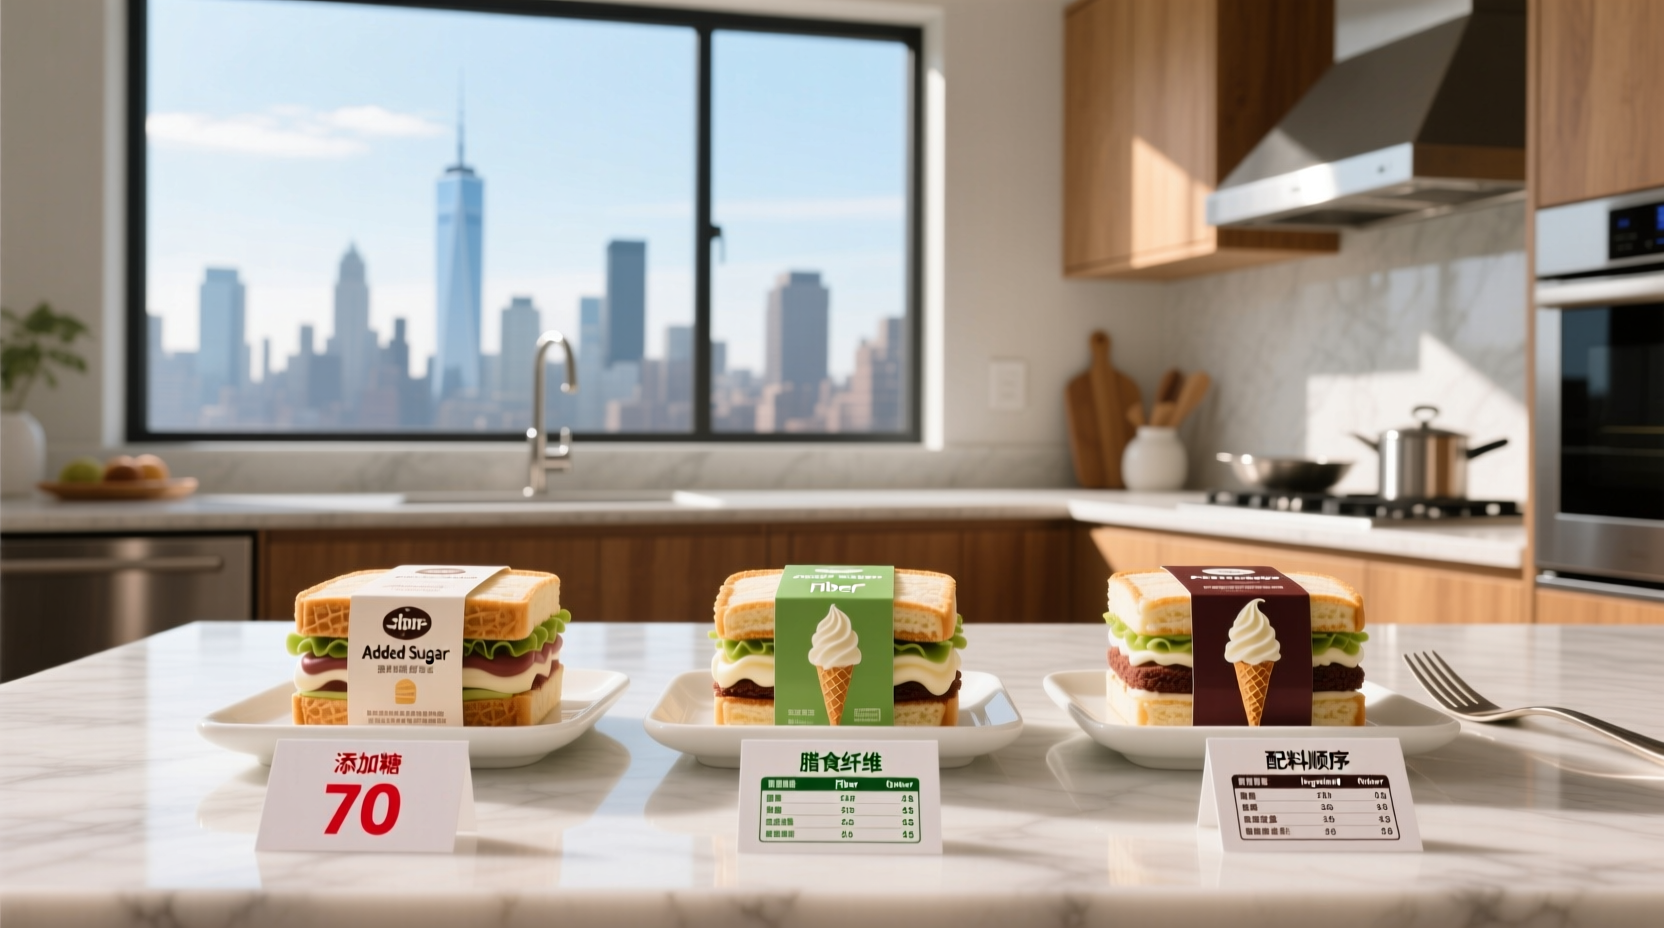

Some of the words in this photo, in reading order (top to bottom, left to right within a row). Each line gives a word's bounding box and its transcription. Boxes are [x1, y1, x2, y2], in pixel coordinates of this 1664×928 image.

[362, 645, 406, 660] Added
[409, 645, 450, 665] Sugar
[334, 752, 402, 775] 添加糖
[1265, 749, 1350, 771] 配料顺序
[324, 783, 401, 835] 70
